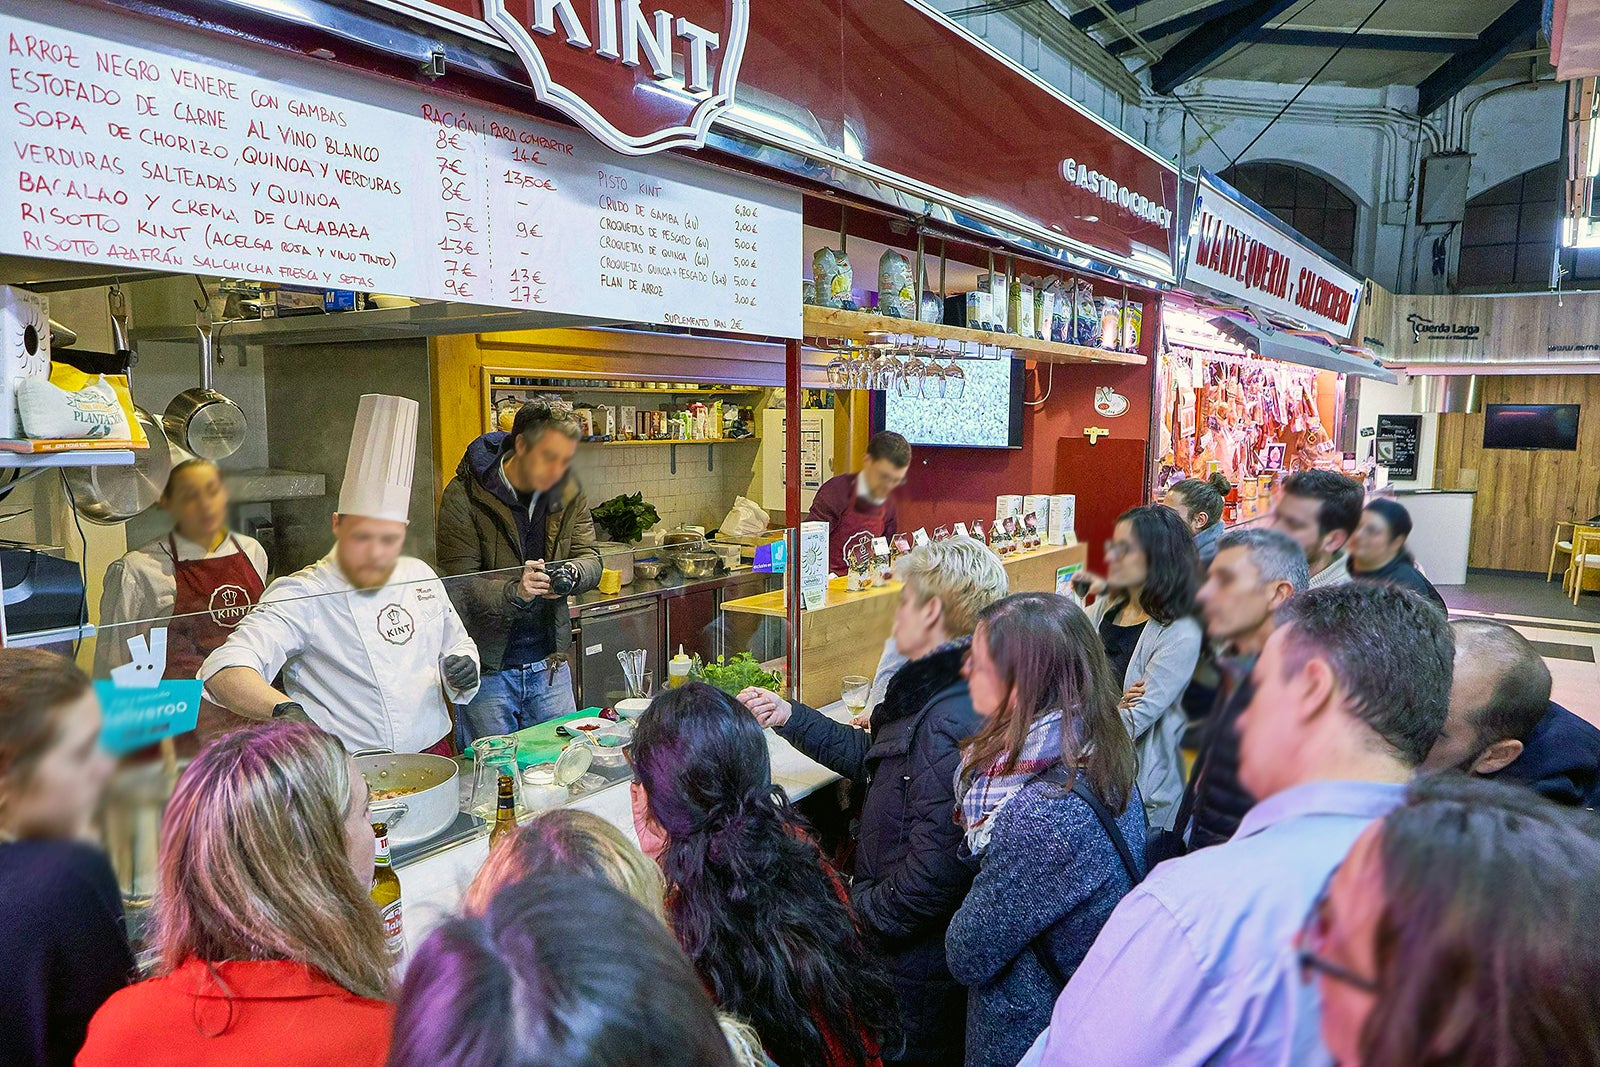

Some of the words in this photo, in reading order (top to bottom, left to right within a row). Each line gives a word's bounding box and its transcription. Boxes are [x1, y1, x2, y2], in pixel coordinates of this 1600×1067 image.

[531, 0, 719, 93] KINT
[8, 32, 80, 68] ARROZ
[96, 51, 160, 82] NEGRO
[171, 67, 239, 100] VENERE
[251, 89, 279, 109] CON
[288, 99, 347, 127] GAMBAS
[10, 68, 121, 105] ESTOFADO
[136, 94, 160, 116] DE
[173, 102, 228, 130] CARNE
[247, 119, 271, 140] AL
[277, 124, 317, 149] VINO
[325, 136, 380, 162] BLANCO
[421, 103, 479, 136] RACIÓN
[14, 102, 87, 135] SOPA
[108, 122, 132, 140] DE
[242, 145, 314, 178] QUINOA
[319, 162, 329, 178] Y
[335, 168, 402, 195] VERDURAS
[435, 128, 467, 150] 8€
[490, 121, 516, 142] PARA
[519, 131, 574, 157] COMPARTIR
[436, 156, 467, 176] 7€
[511, 146, 548, 166] 14€
[14, 141, 125, 175] VERDURAS
[141, 160, 237, 193] SALTEADAS
[250, 181, 261, 197] Y
[267, 184, 341, 210] QUINOA
[598, 170, 628, 191] PISTO
[638, 183, 662, 198] KINT
[441, 176, 472, 201] 8€
[1060, 157, 1173, 230] GASTROCRACY
[145, 193, 160, 211] Y
[172, 198, 239, 224] CREMA
[254, 209, 275, 225] DE
[284, 214, 370, 241] CALABAZA
[445, 211, 479, 233] 5€
[598, 194, 629, 213] CRUDO
[635, 203, 645, 217] DE
[650, 208, 679, 226] GAMBA
[21, 203, 120, 233] RISOTTO
[137, 219, 192, 241] KINT
[204, 223, 274, 251] (ACELGA
[280, 241, 312, 256] ROJA
[316, 246, 325, 257] Y
[330, 249, 356, 263] VINO
[359, 251, 398, 270] TINTO)
[515, 221, 543, 239] 9€
[599, 216, 645, 237] CROQUETAS
[648, 227, 658, 239] DE
[662, 229, 692, 246] PESCADO
[437, 235, 480, 256] 13€
[599, 235, 644, 254] CROQUETAS
[648, 245, 657, 256] DE
[661, 249, 688, 262] QUINOA
[1195, 211, 1291, 300] MANTEQUERIA
[23, 231, 99, 257] RISOTTO
[106, 243, 183, 266] AZAFRÁN
[193, 254, 274, 276] SALCHICHA
[278, 265, 319, 281] FRESCA
[322, 272, 332, 282] Y
[339, 273, 376, 289] SETAS
[443, 259, 478, 278] 7€
[600, 255, 644, 273] CROQUETAS
[443, 279, 474, 297] 9€
[509, 268, 547, 285] 13€
[600, 274, 623, 288] FLAN
[628, 278, 638, 291] DE
[641, 282, 664, 297] ARROZ
[508, 286, 548, 304] 17€
[664, 312, 710, 328] SUPLEMENTO
[713, 319, 727, 329] PAN
[730, 318, 744, 331] 2€
[1416, 323, 1450, 333] Cuerda
[1452, 324, 1480, 335] Larga
[217, 606, 246, 620] KINT
[386, 623, 412, 638] KINT
